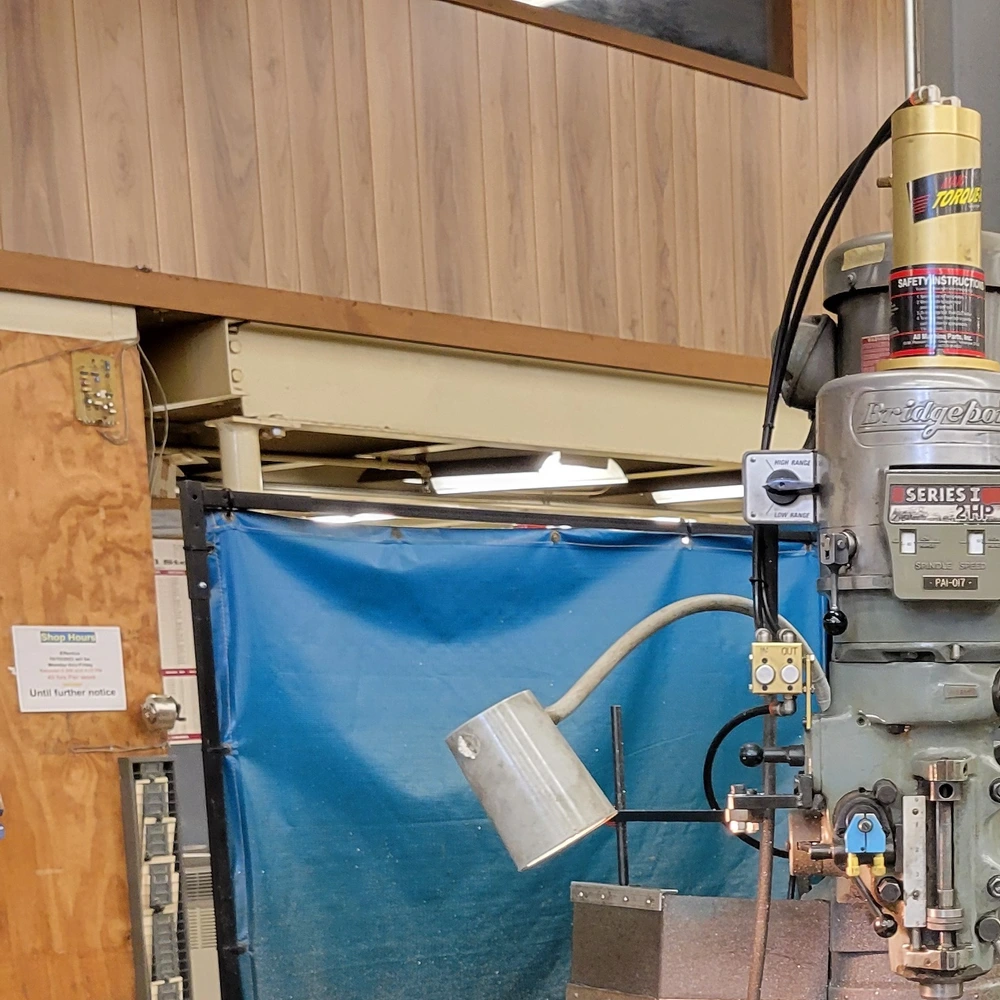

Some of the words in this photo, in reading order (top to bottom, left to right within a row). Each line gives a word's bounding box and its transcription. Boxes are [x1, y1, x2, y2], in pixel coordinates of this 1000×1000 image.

[898, 276, 928, 288] SAFETY
[930, 275, 985, 291] INSTRUCTION
[906, 487, 966, 502] SERIES
[970, 487, 981, 502] I
[915, 562, 953, 571] SPINDLE
[959, 562, 987, 571] SPEED
[41, 632, 65, 643] Shop
[67, 632, 96, 643] Hours
[782, 647, 797, 655] OUT
[30, 689, 52, 697] Until
[54, 688, 85, 697] further
[88, 688, 116, 696] notice
